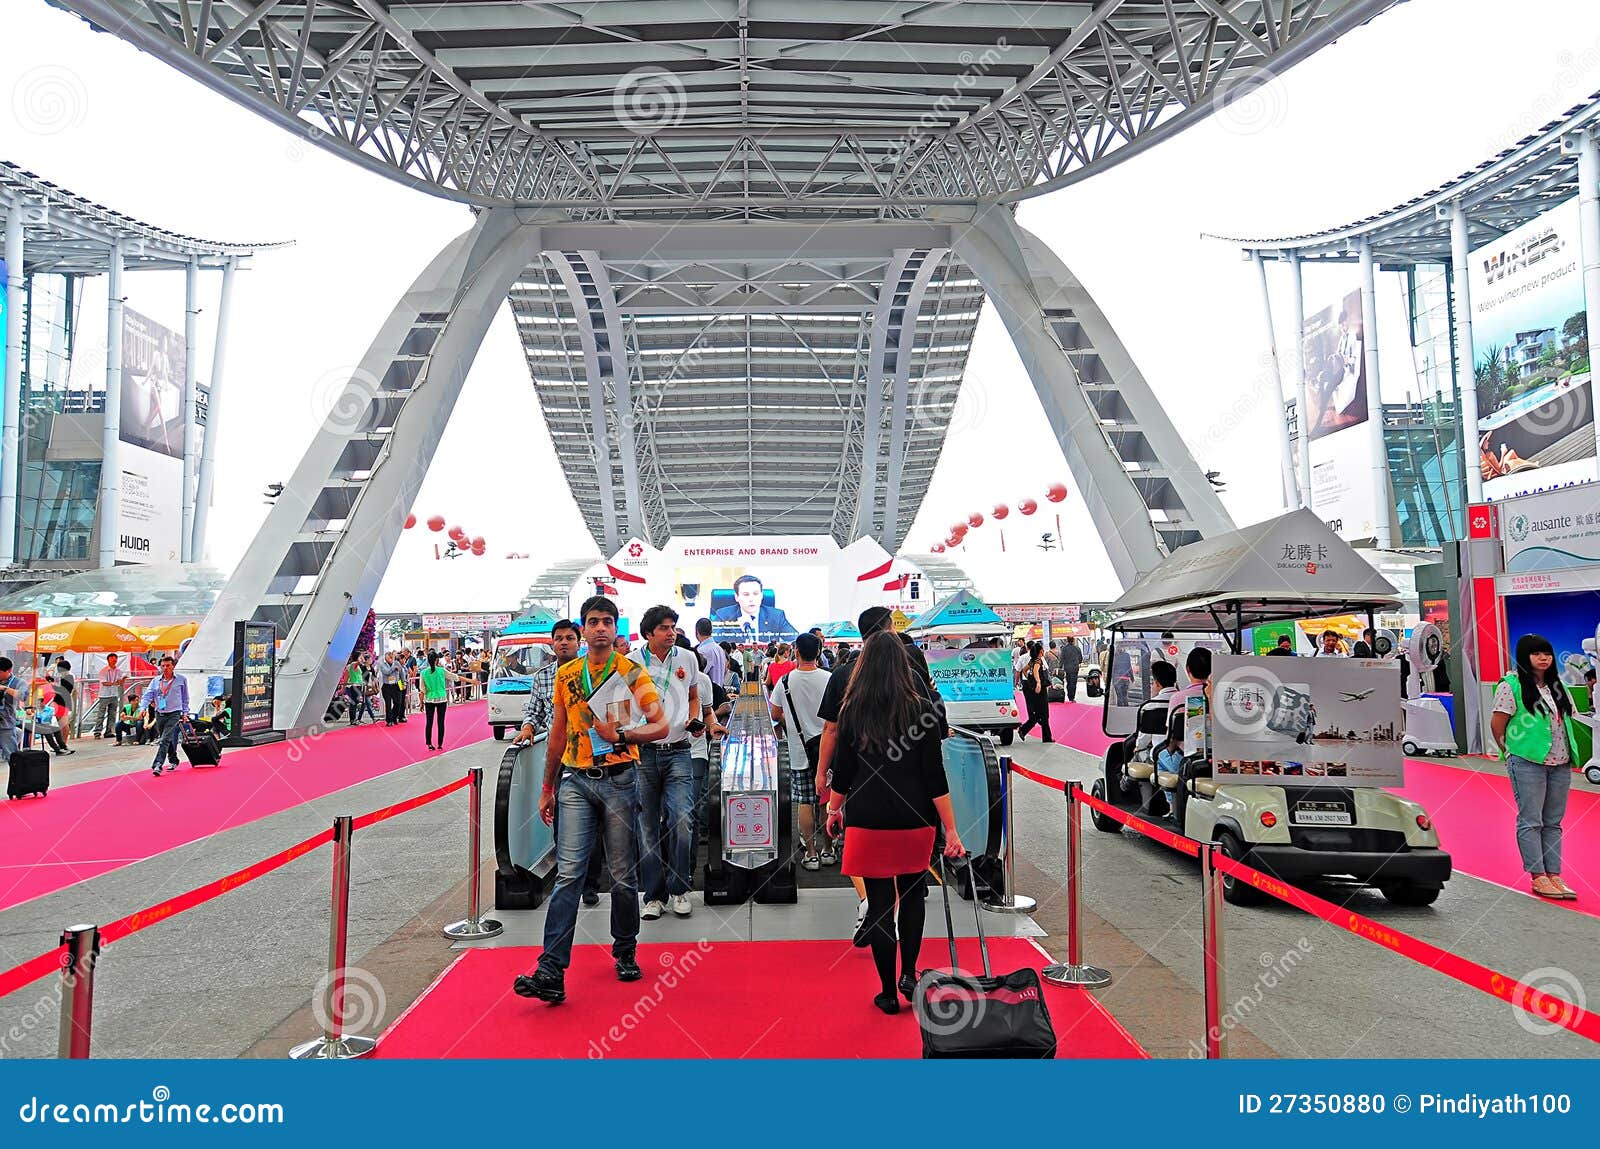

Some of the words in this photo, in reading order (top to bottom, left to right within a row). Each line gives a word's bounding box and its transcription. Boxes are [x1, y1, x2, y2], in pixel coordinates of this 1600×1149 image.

[1541, 261, 1576, 288] product
[1531, 516, 1571, 532] ausante
[120, 534, 150, 551] HUIDA
[1281, 544, 1328, 561] 龙腾卡
[932, 667, 1007, 679] 欢迎采购乐从家具
